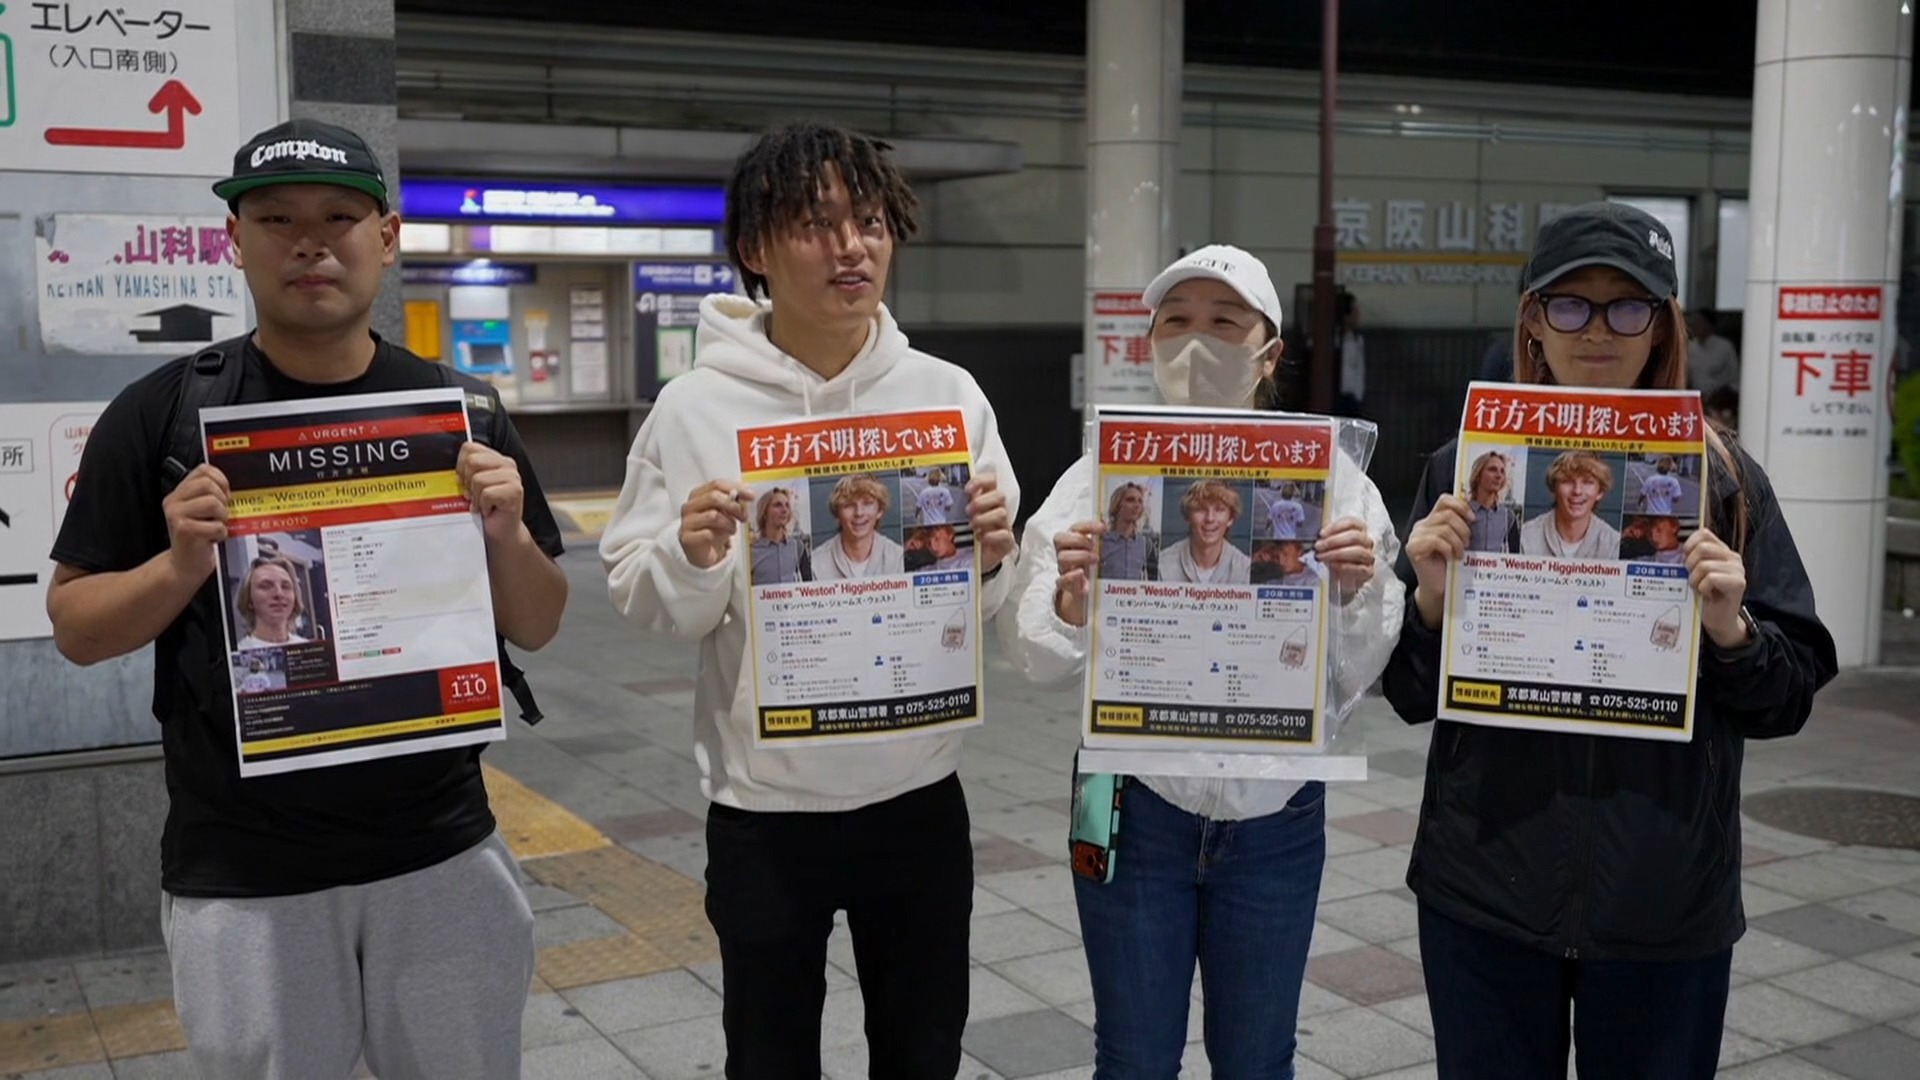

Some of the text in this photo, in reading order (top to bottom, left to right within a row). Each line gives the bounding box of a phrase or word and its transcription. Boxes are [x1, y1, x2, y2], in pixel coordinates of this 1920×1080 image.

[30, 2, 211, 40] エレベーター
[48, 44, 180, 75] （入口南側）
[250, 139, 348, 168] Compton
[1332, 199, 1574, 251] 京阪山科
[114, 274, 199, 298] YAMASHINA
[207, 275, 239, 299] STA.
[1781, 349, 1873, 397] 下車
[1474, 396, 1699, 438] 行方不明探しています
[312, 425, 366, 440] URGENT
[268, 439, 411, 473] MISSING
[750, 423, 958, 468] 行方不明探しています
[1109, 430, 1323, 466] 行方不明探しています
[227, 493, 265, 509] ames
[267, 487, 331, 504] "Weston"
[335, 478, 427, 500] Higginbotham
[272, 515, 309, 527] KYOTO
[1462, 554, 1621, 577] James "Weston" Higginbotham
[760, 589, 793, 601] James
[795, 582, 839, 598] "Weston"
[840, 578, 908, 596] Higginbotham
[1104, 584, 1252, 602] James "Weston" Higginbotham
[450, 677, 488, 699] 110
[1506, 686, 1583, 706] 京都東山警察署
[817, 704, 888, 722] 京都東山警察署
[906, 693, 970, 714] 075-525-0110
[1602, 696, 1679, 714] 075-525-0110
[1148, 709, 1219, 725] 京都東山警察署
[1236, 713, 1307, 729] 075-525-0110
